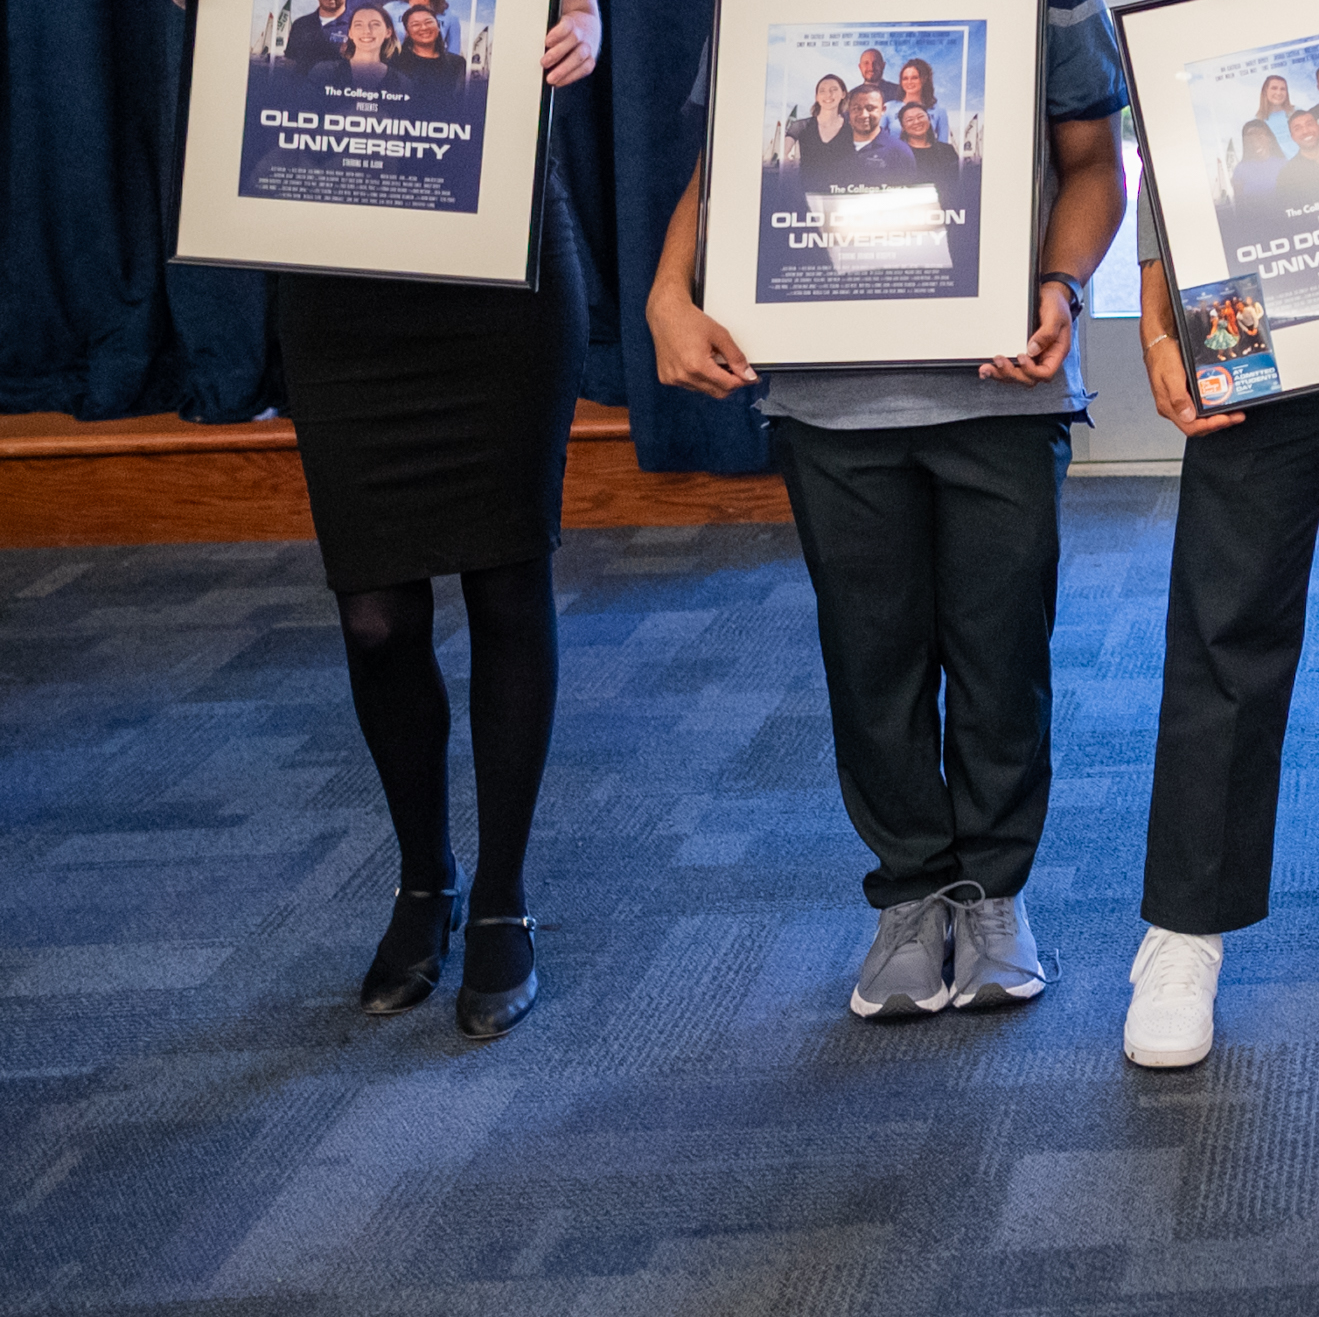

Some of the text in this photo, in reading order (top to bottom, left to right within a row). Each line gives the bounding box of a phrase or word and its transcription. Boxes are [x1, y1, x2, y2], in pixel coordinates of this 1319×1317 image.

[325, 86, 403, 100] The College Tour
[261, 110, 470, 140] OLD DOMINION
[279, 133, 450, 159] UNIVERSITY
[771, 212, 824, 228] OLD
[1286, 208, 1302, 217] The
[788, 230, 948, 248] UNIVERSITY
[1237, 238, 1290, 262] OLD
